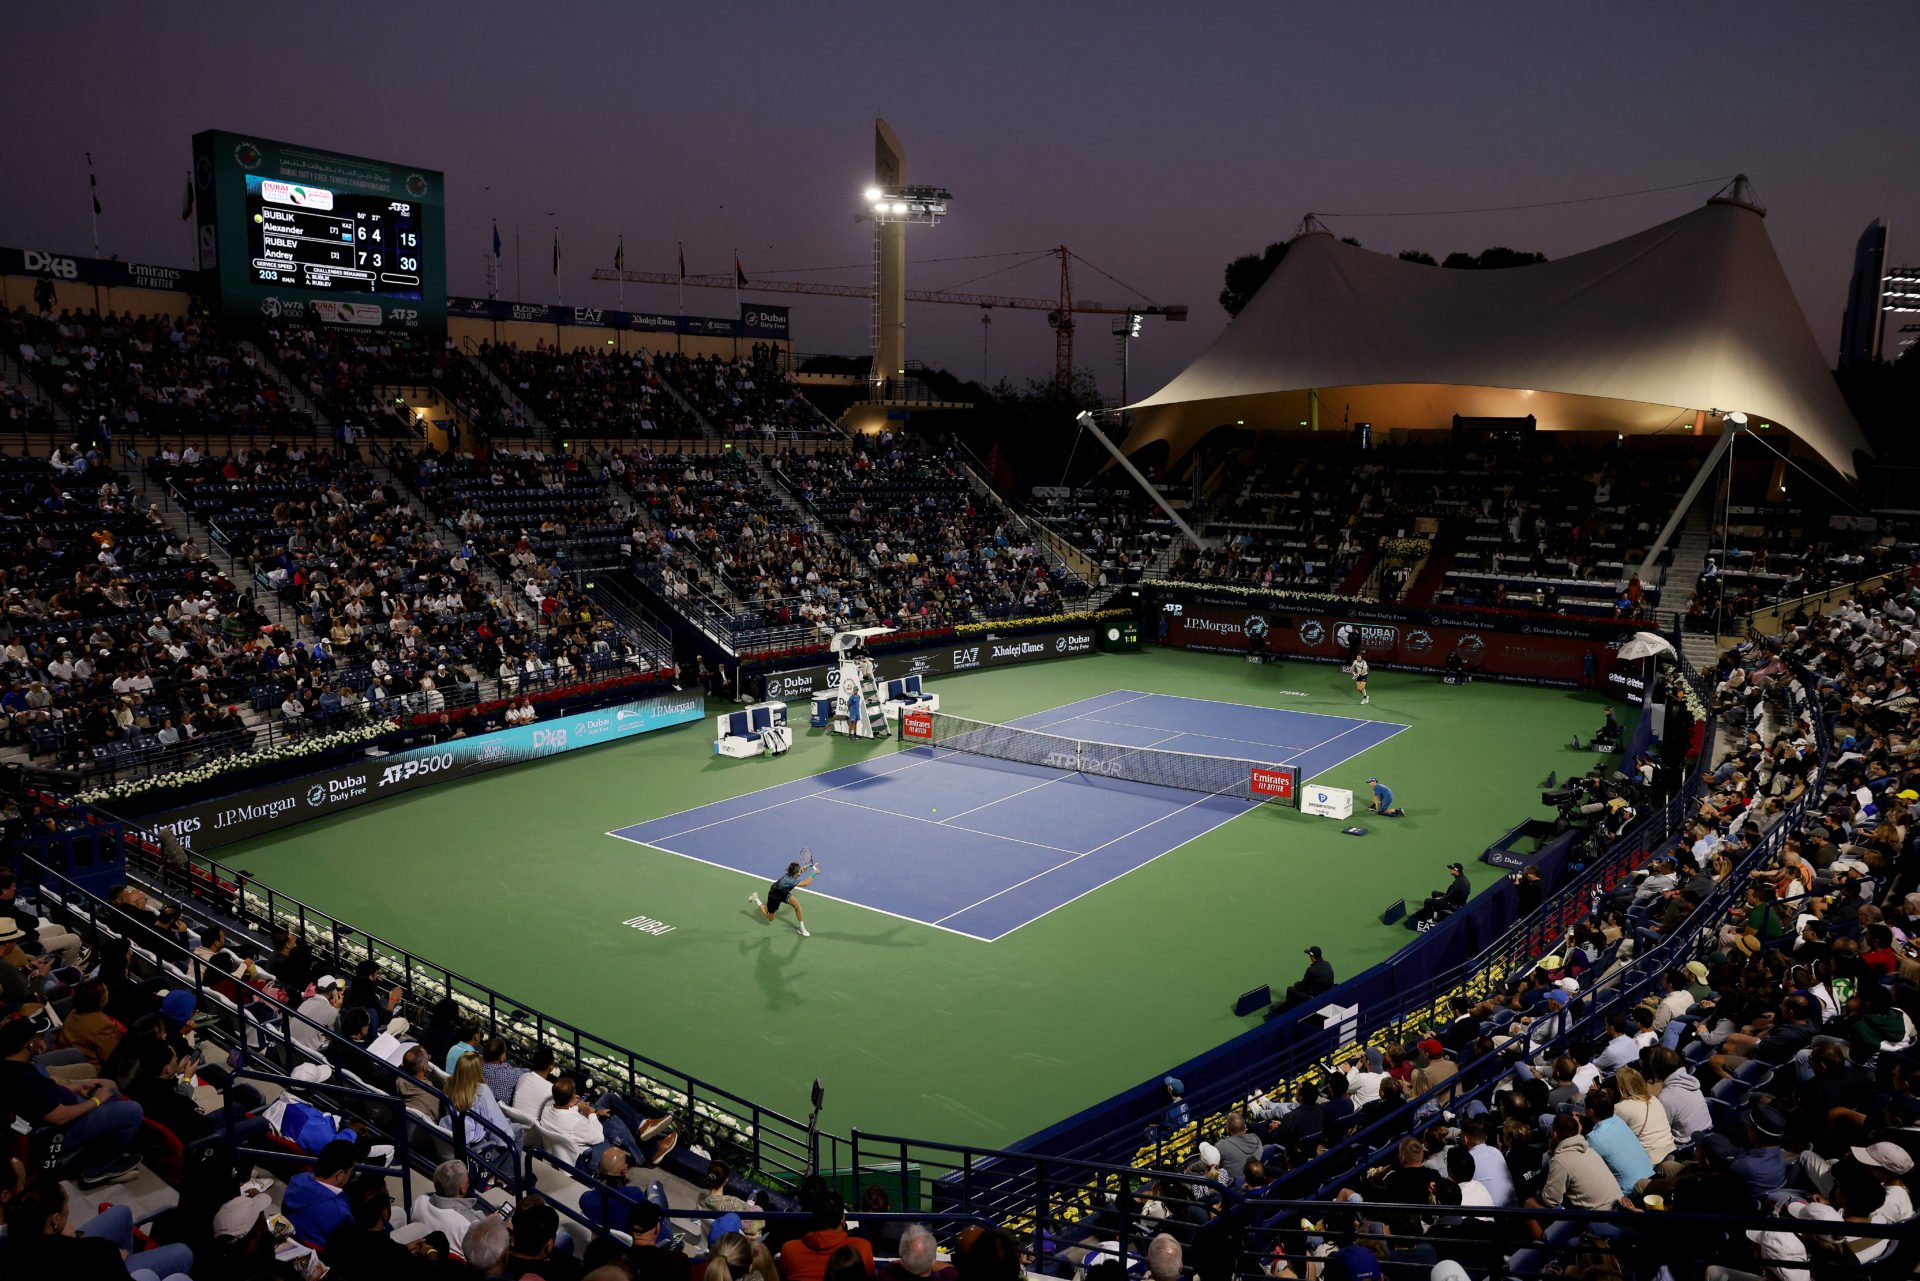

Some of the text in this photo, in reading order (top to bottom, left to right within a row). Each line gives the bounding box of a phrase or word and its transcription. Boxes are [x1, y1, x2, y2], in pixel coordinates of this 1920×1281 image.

[388, 202, 410, 212] ATP
[264, 210, 295, 222] BUBLIK
[264, 222, 304, 235] Alexander
[358, 227, 416, 246] 6 4 15
[265, 237, 298, 248] RUBLEV
[265, 250, 293, 260] Andrey
[358, 252, 416, 271] 7 3 30
[128, 263, 180, 280] Emirates
[260, 270, 278, 280] 203
[282, 300, 304, 309] WTA
[388, 308, 418, 321] ATP
[574, 307, 604, 322] EA7
[760, 312, 786, 323] Dubai
[1162, 604, 1182, 612] ATP
[1464, 620, 1479, 628] Duty
[1361, 627, 1394, 637] DUBAI
[1068, 635, 1090, 644] Dubai
[1022, 642, 1044, 654] Times
[954, 648, 979, 664] EA7
[784, 676, 812, 688] Dubai
[784, 688, 798, 696] Duty
[905, 718, 930, 728] Emirates
[1040, 752, 1122, 777] ATP TOUR
[328, 775, 366, 793] Dubai
[1254, 772, 1290, 786] Emirates
[1258, 782, 1284, 792] FLY BETTER
[330, 787, 366, 802] Duty Free
[622, 916, 677, 936] DUBAI
[50, 1144, 62, 1152] 13
[43, 1160, 56, 1168] 31
